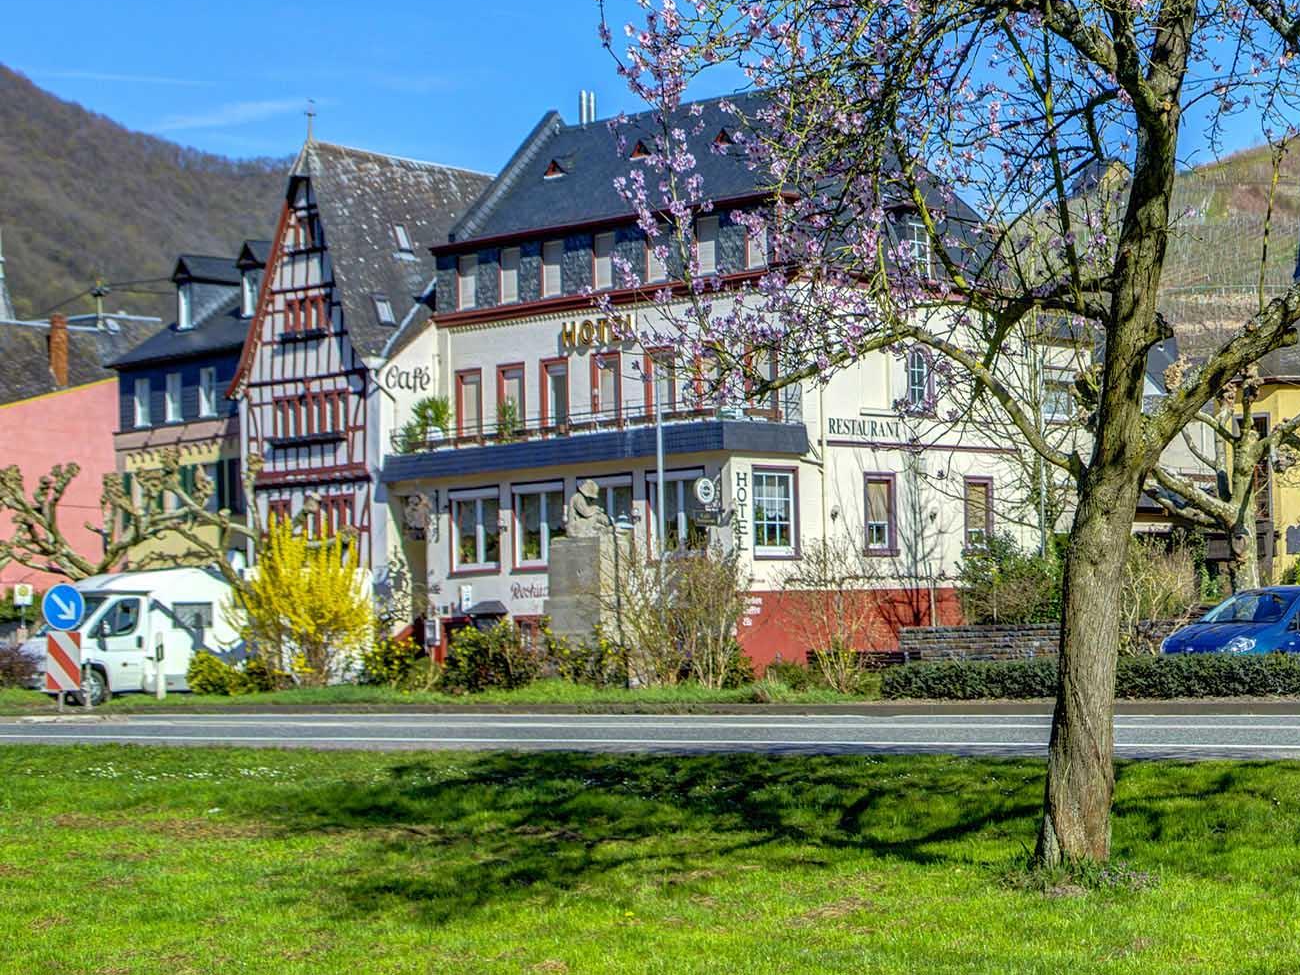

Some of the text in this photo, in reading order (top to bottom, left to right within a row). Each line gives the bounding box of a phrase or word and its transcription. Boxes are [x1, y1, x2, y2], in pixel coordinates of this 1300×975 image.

[385, 365, 431, 394] Café
[828, 418, 901, 438] RESTAURANT
[735, 471, 749, 552] HOTEL
